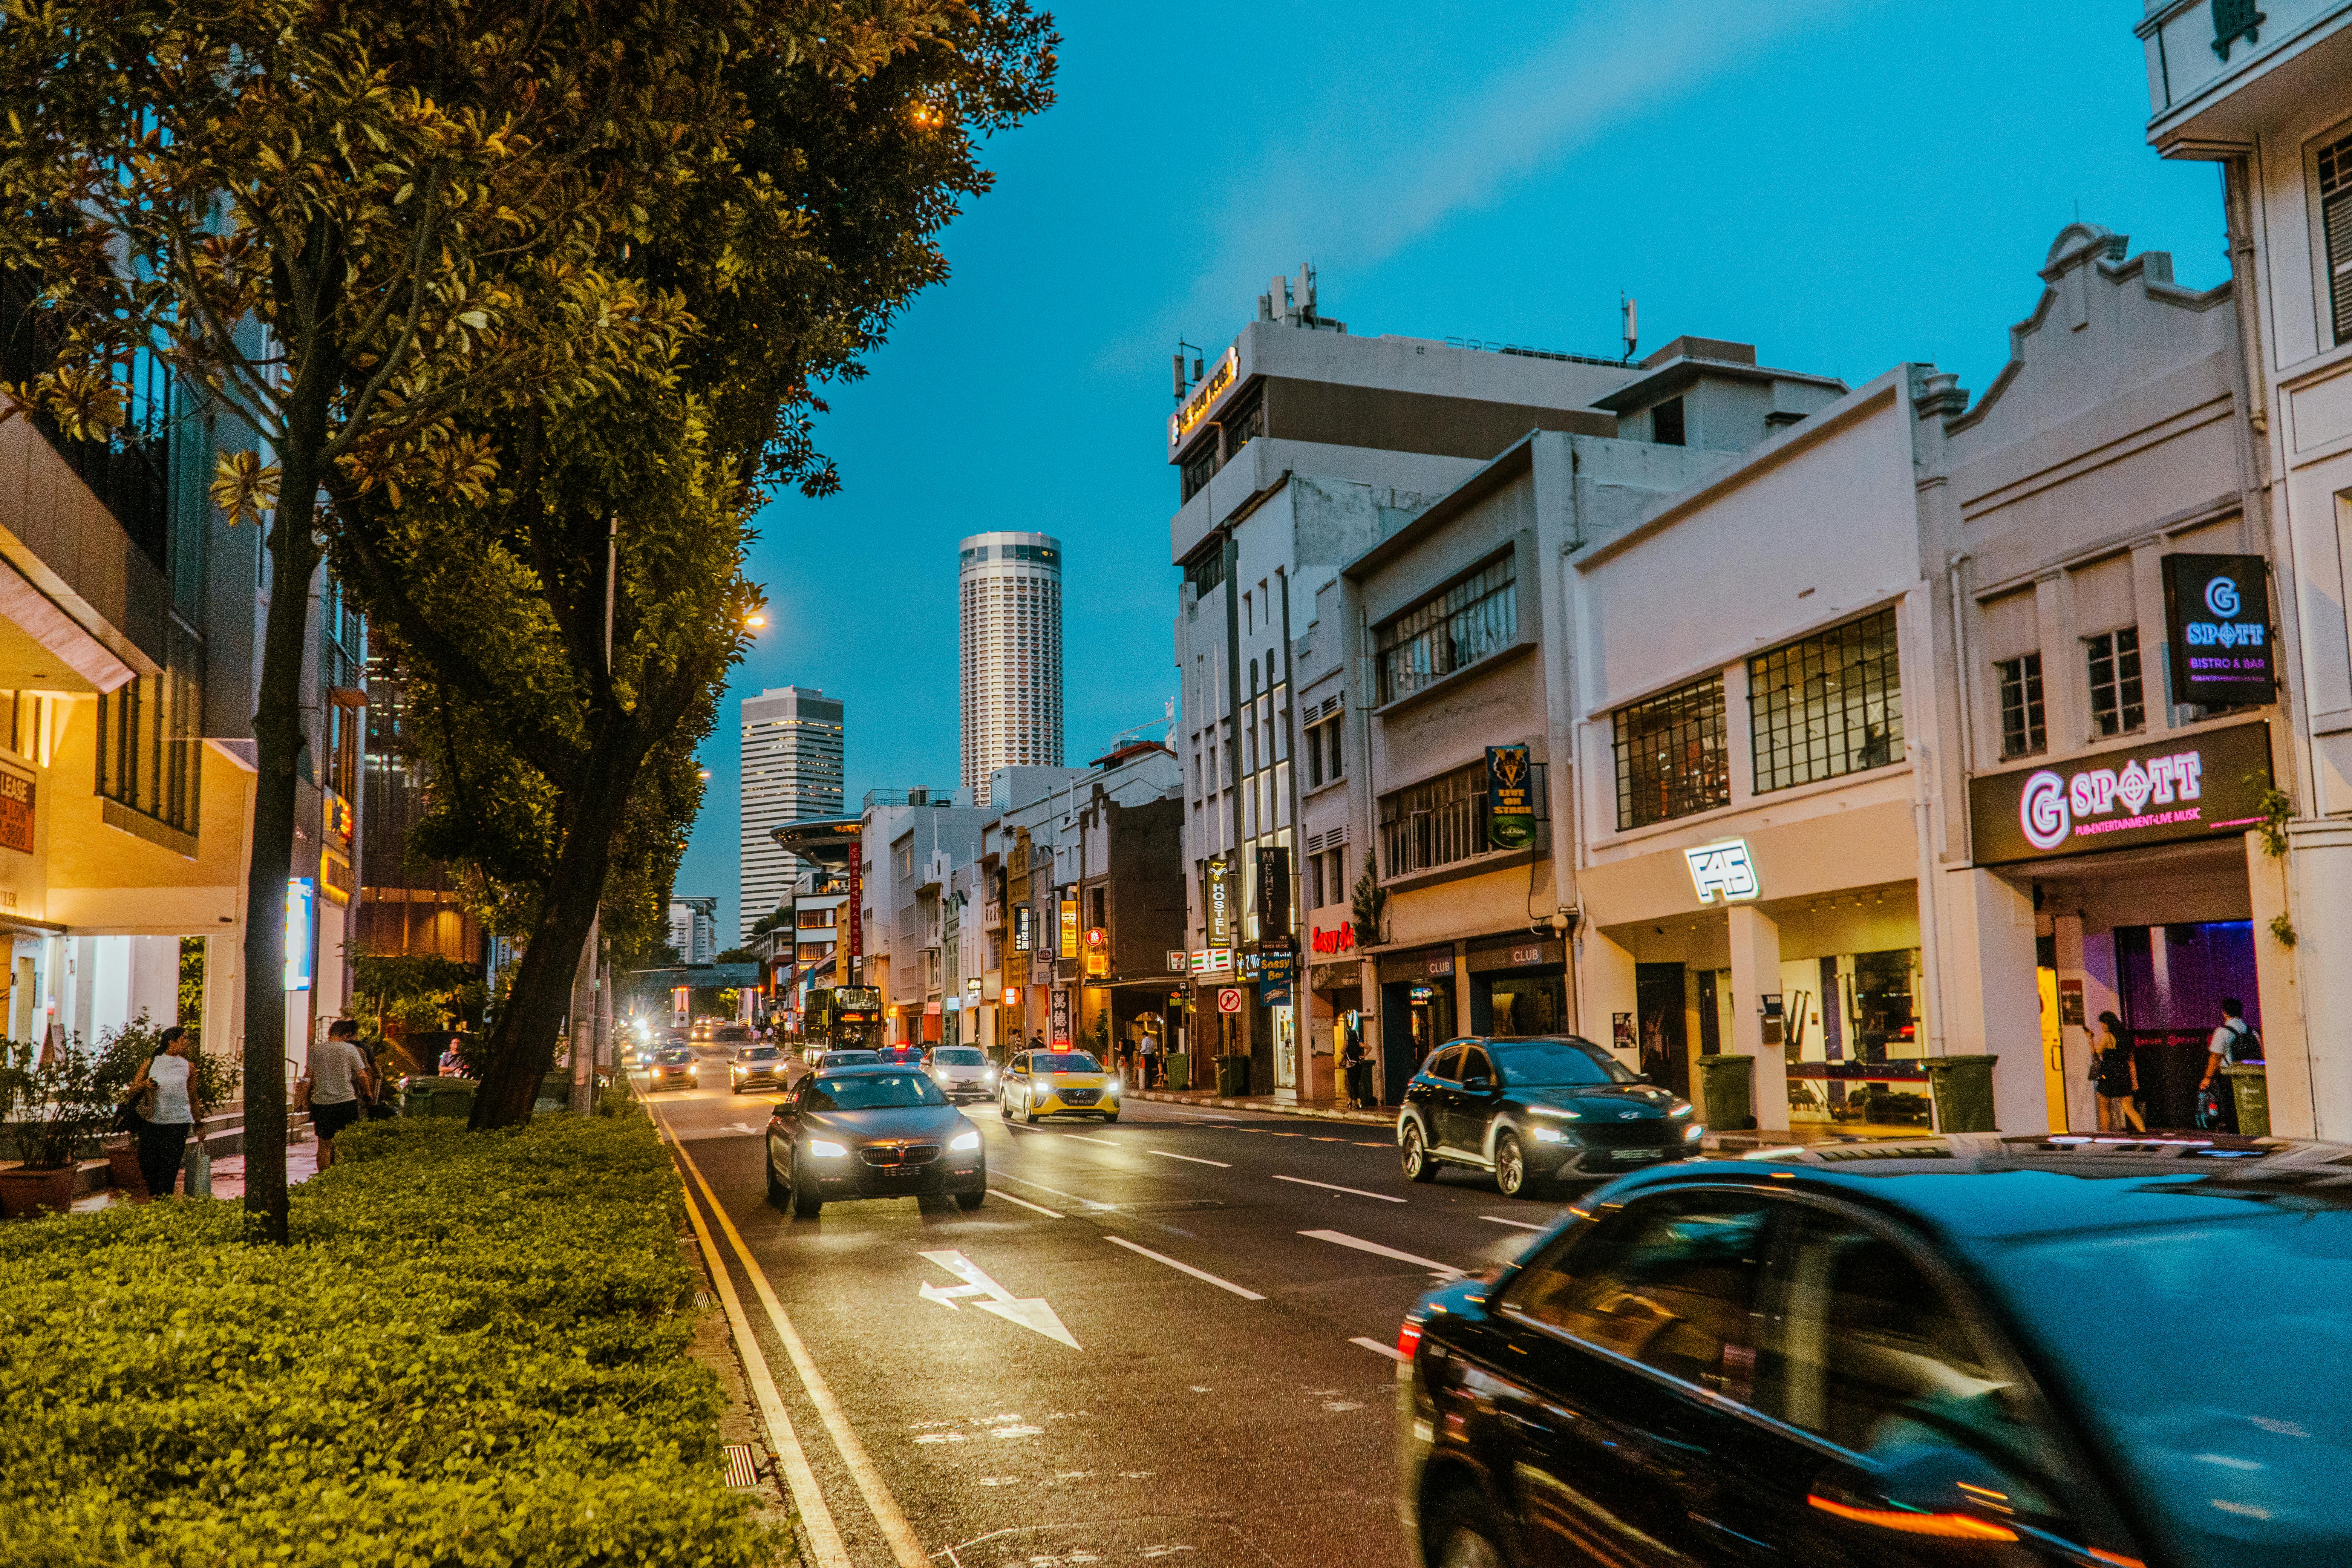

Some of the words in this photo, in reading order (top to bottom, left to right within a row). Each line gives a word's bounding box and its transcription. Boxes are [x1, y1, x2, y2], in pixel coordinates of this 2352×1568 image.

[2205, 576, 2241, 619] G
[2190, 657, 2231, 669] BISTRO
[2233, 658, 2240, 669] &
[2243, 658, 2265, 669] BAR
[1, 773, 27, 803] LEASE
[2020, 770, 2070, 850] G
[2173, 806, 2201, 821] MUSIC
[1686, 842, 1756, 901] F45
[1213, 884, 1225, 935] HOSTEL
[1312, 926, 1338, 954] Sassy
[1340, 921, 1354, 952] Ba
[1261, 959, 1290, 969] Sassy
[1514, 949, 1538, 962] CLUB
[1268, 971, 1284, 981] Bar
[1430, 962, 1449, 974] CLUB
